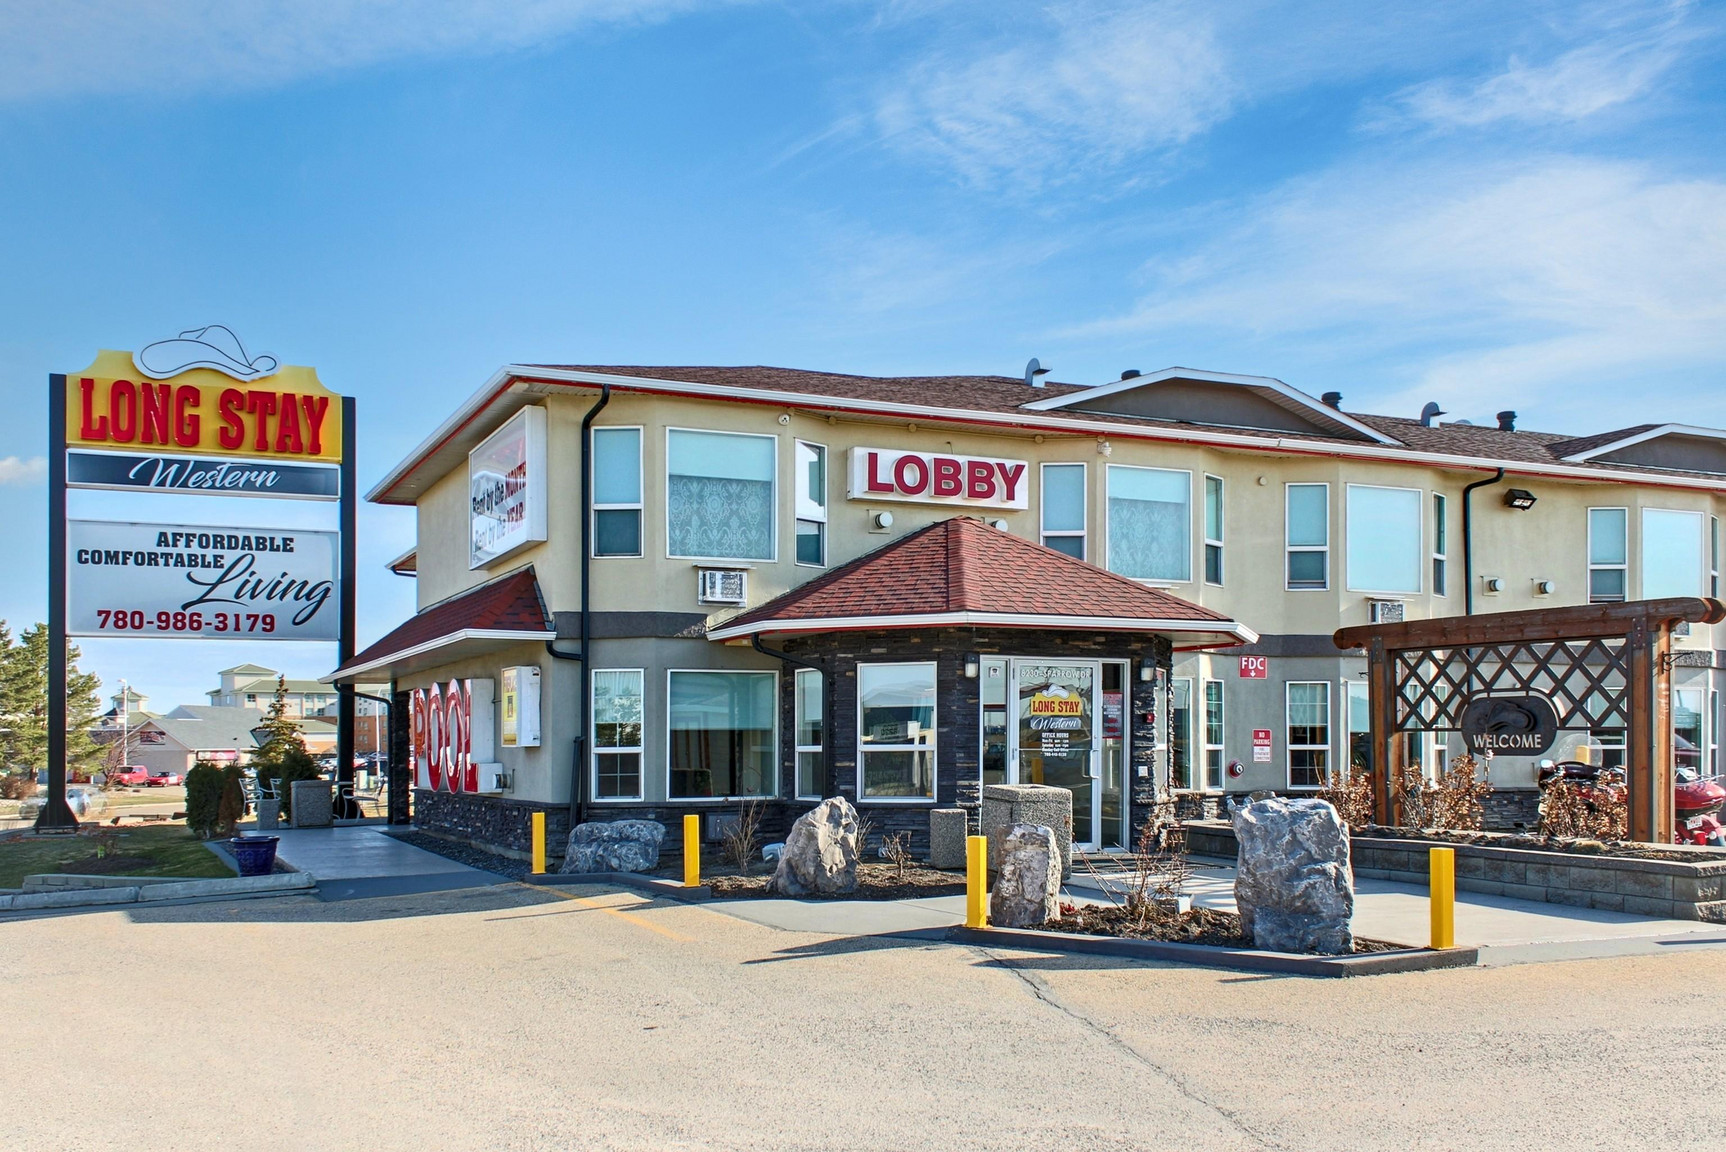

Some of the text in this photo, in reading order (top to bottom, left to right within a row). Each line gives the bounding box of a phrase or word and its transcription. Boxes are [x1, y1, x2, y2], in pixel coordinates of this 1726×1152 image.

[79, 377, 329, 455] LONG STAY
[128, 457, 281, 489] Western
[867, 452, 1026, 501] LOBBY
[472, 493, 485, 514] Rent
[486, 488, 494, 514] by
[495, 481, 504, 506] the
[507, 502, 523, 534] YEAR
[156, 531, 295, 553] AFFORDABLE
[77, 549, 225, 569] COMFORTABLE
[181, 553, 334, 626] Living
[97, 609, 276, 633] 780-986-3179
[1241, 657, 1264, 670] FDC
[1033, 700, 1080, 713] LONG STAY
[413, 678, 479, 794] POOL
[1032, 717, 1077, 730] Western
[1472, 734, 1542, 748] WELCOME
